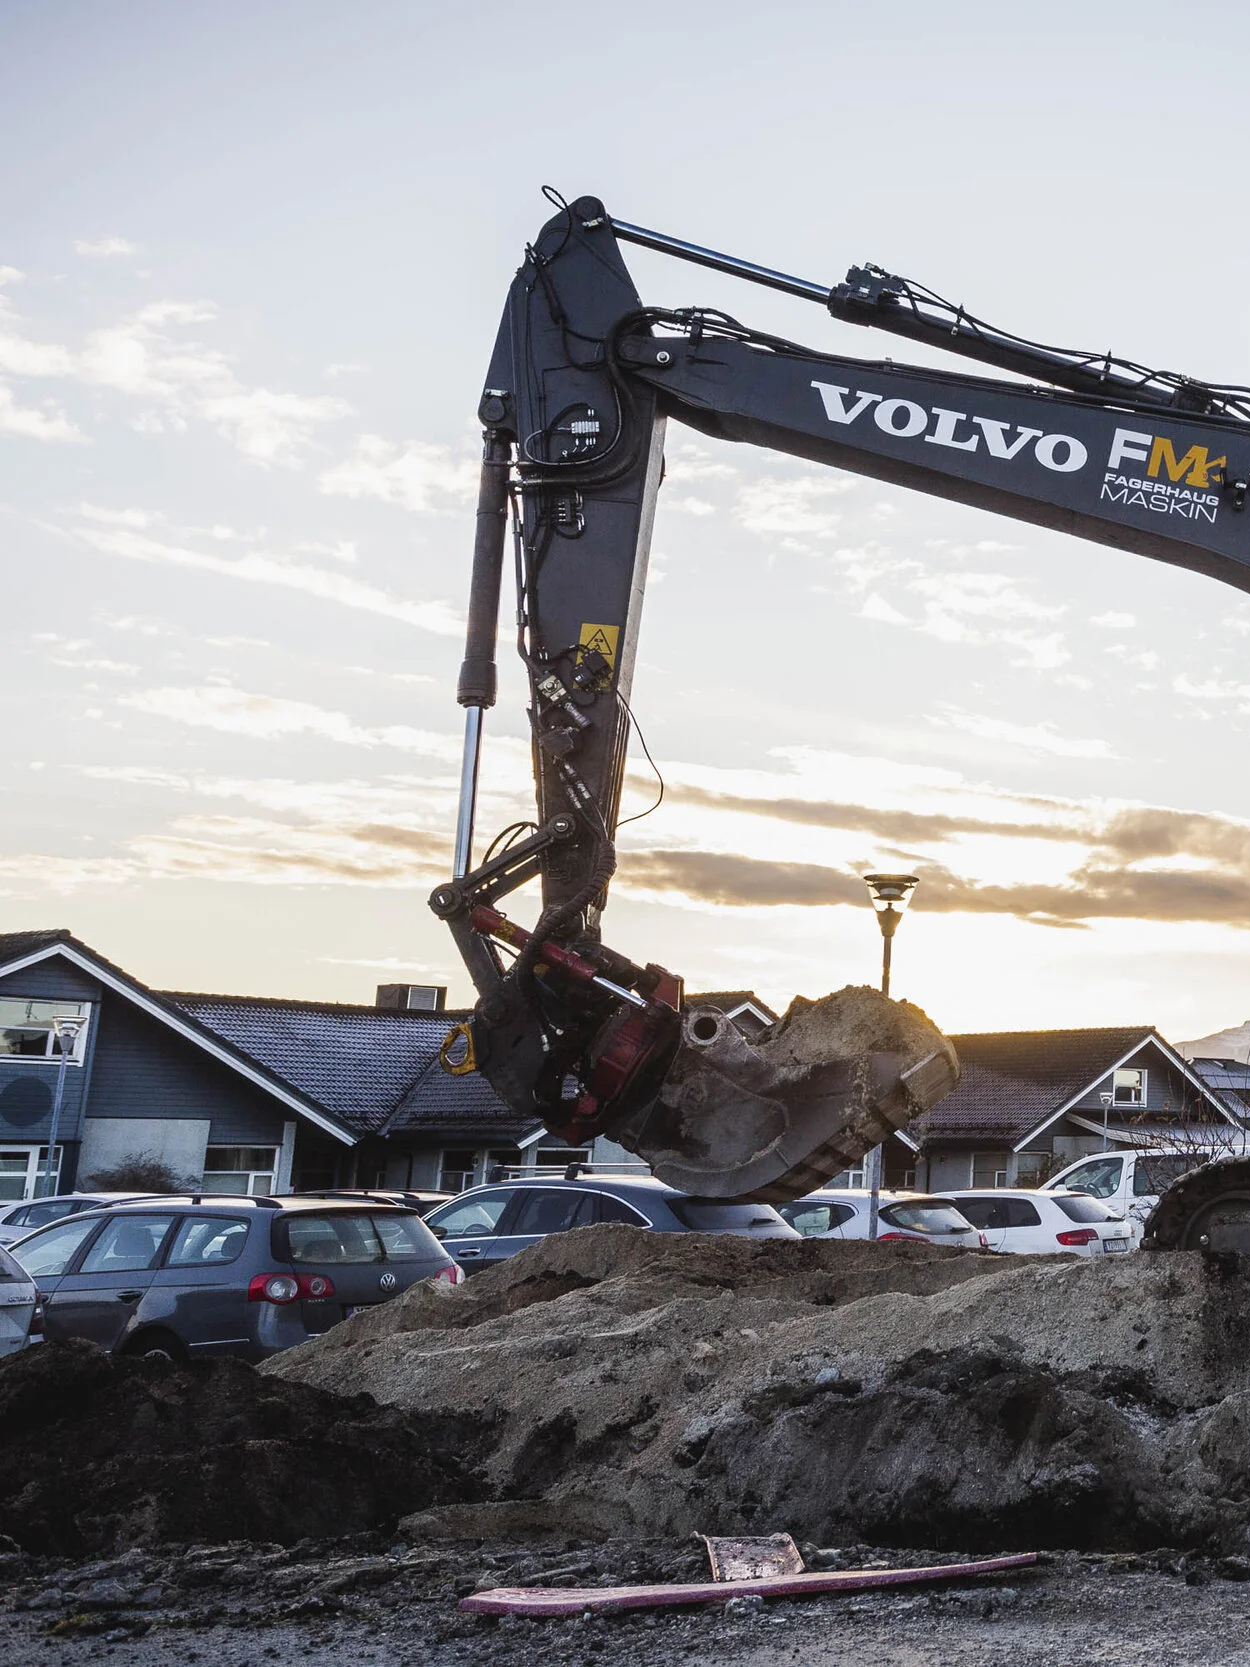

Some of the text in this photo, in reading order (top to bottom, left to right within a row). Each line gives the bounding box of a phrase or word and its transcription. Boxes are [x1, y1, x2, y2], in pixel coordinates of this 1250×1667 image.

[810, 380, 1088, 473] VOLVO
[1100, 483, 1218, 523] MASKIN
[1104, 472, 1220, 506] FAGERHAUG
